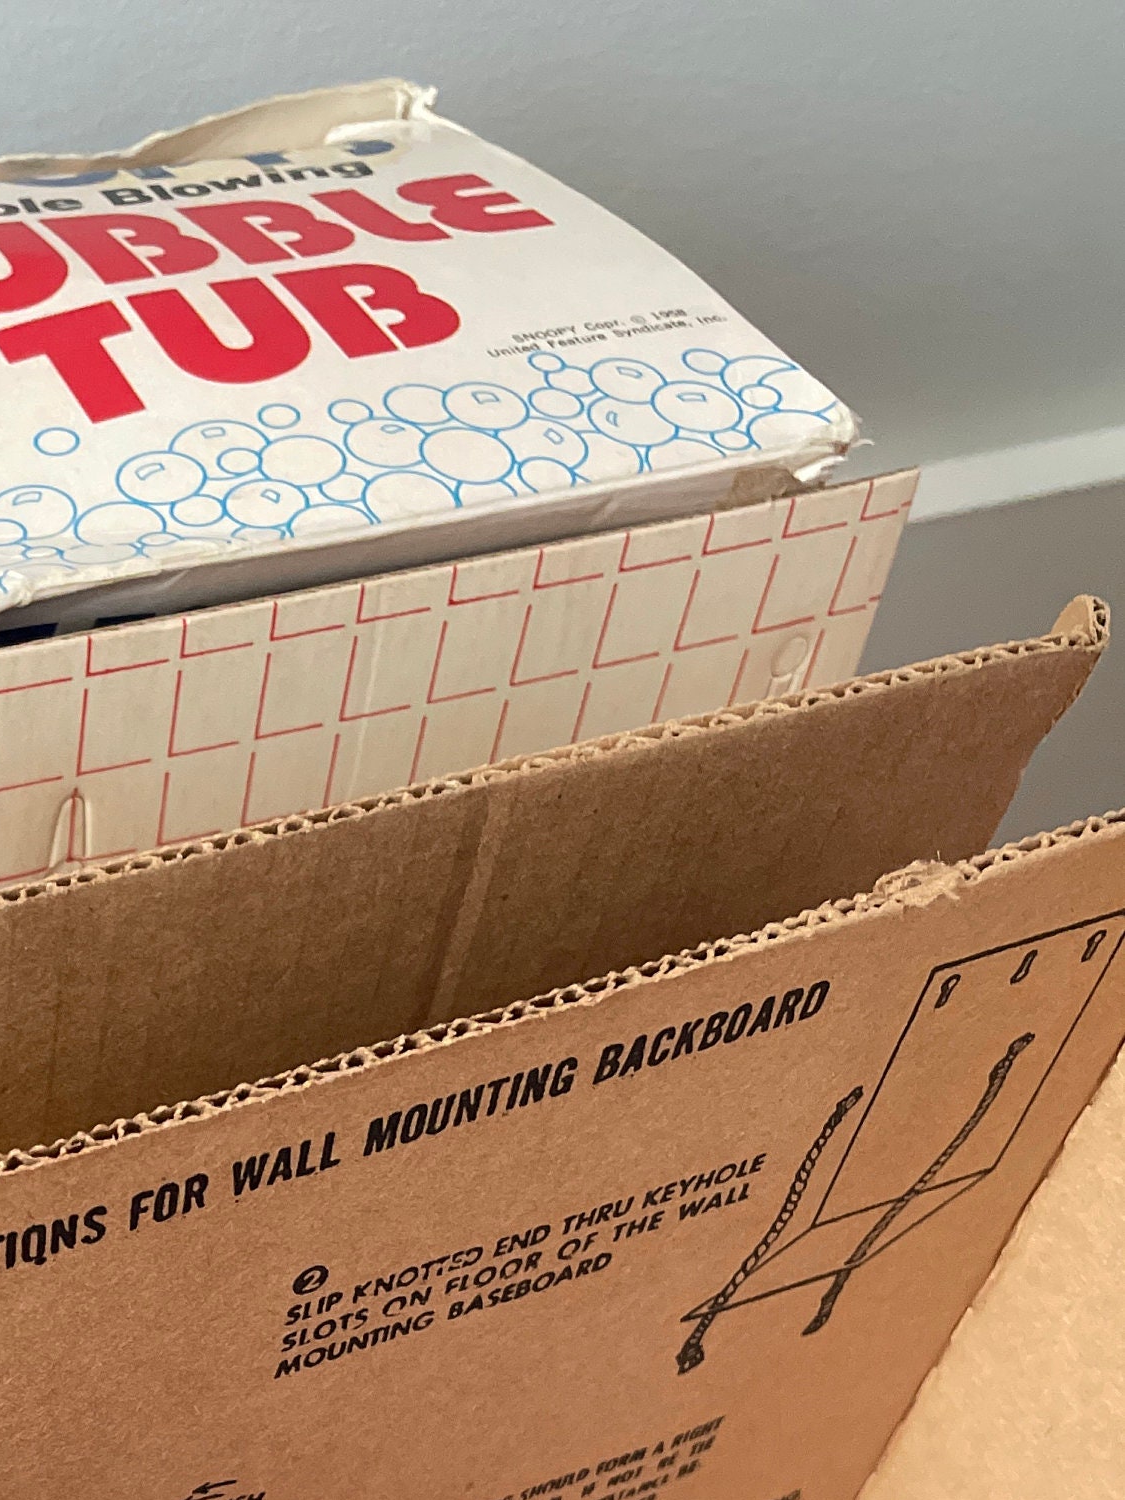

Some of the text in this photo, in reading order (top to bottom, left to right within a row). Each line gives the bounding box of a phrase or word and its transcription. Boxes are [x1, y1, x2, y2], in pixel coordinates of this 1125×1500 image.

[101, 159, 374, 206] Blowing
[487, 342, 540, 358] United
[547, 333, 606, 349] Feature
[697, 313, 728, 325] Inc.
[512, 325, 575, 344] SNOOPY
[127, 1172, 210, 1231] FOR
[232, 1131, 341, 1197] WALL
[363, 1057, 579, 1157] MOUNTING
[592, 979, 831, 1085] BACKBOARD
[281, 1182, 750, 1353] SLOTS ON FLOOR OF THE WALL
[284, 1152, 767, 1326] SLIP KNOTTED END THRU KEYHOLE
[274, 1252, 613, 1379] MOUNTING BASEBOARD
[595, 1447, 648, 1476] FORM
[652, 1441, 665, 1455] A
[671, 1414, 726, 1449] RIGHT
